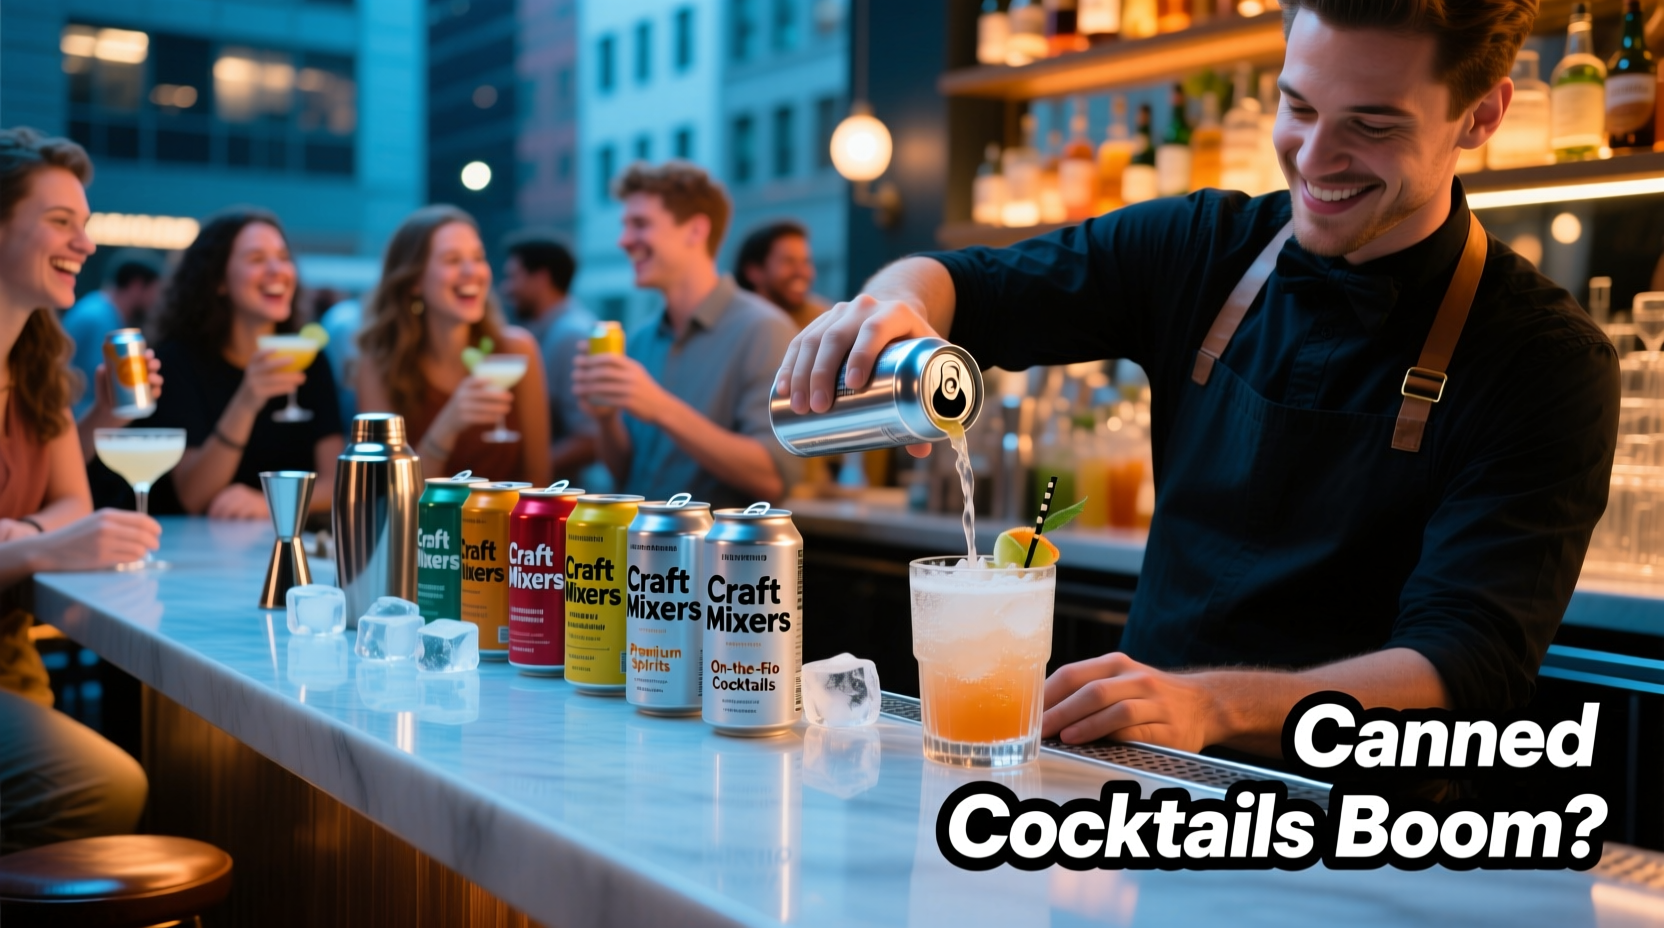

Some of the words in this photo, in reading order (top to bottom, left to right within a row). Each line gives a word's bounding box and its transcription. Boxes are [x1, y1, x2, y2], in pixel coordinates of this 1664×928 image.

[417, 528, 450, 550] Craft
[509, 542, 554, 567] Craft
[509, 565, 565, 590] Mixers
[566, 555, 615, 581] Craft
[627, 565, 690, 594] Craft
[707, 574, 781, 605] Craft
[626, 593, 702, 621] Mixers
[706, 605, 791, 634] Mixers
[631, 658, 671, 673] Spirits
[712, 675, 776, 692] Cocktails
